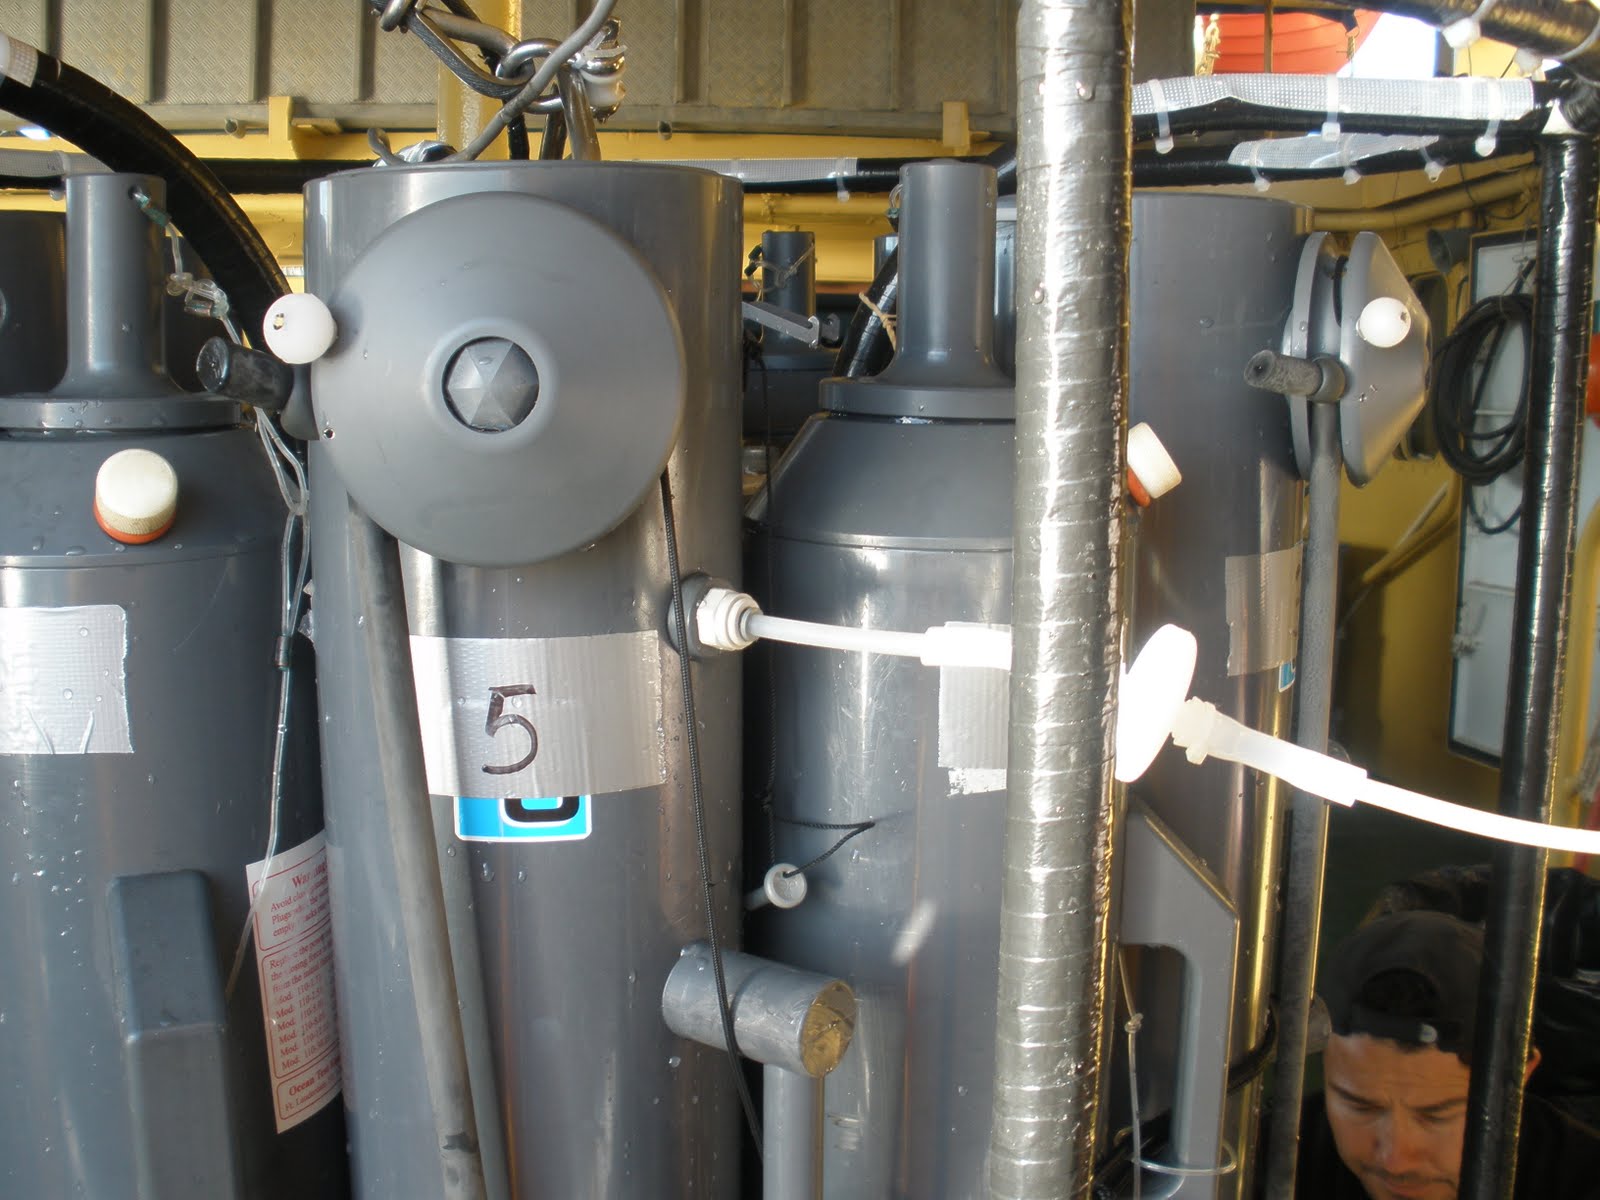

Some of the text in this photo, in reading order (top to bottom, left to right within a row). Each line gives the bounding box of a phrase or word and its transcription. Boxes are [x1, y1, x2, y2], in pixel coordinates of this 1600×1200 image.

[481, 683, 538, 775] 5
[271, 896, 292, 912] Avoid
[271, 911, 292, 925] Plugs
[288, 1076, 315, 1096] Ocean
